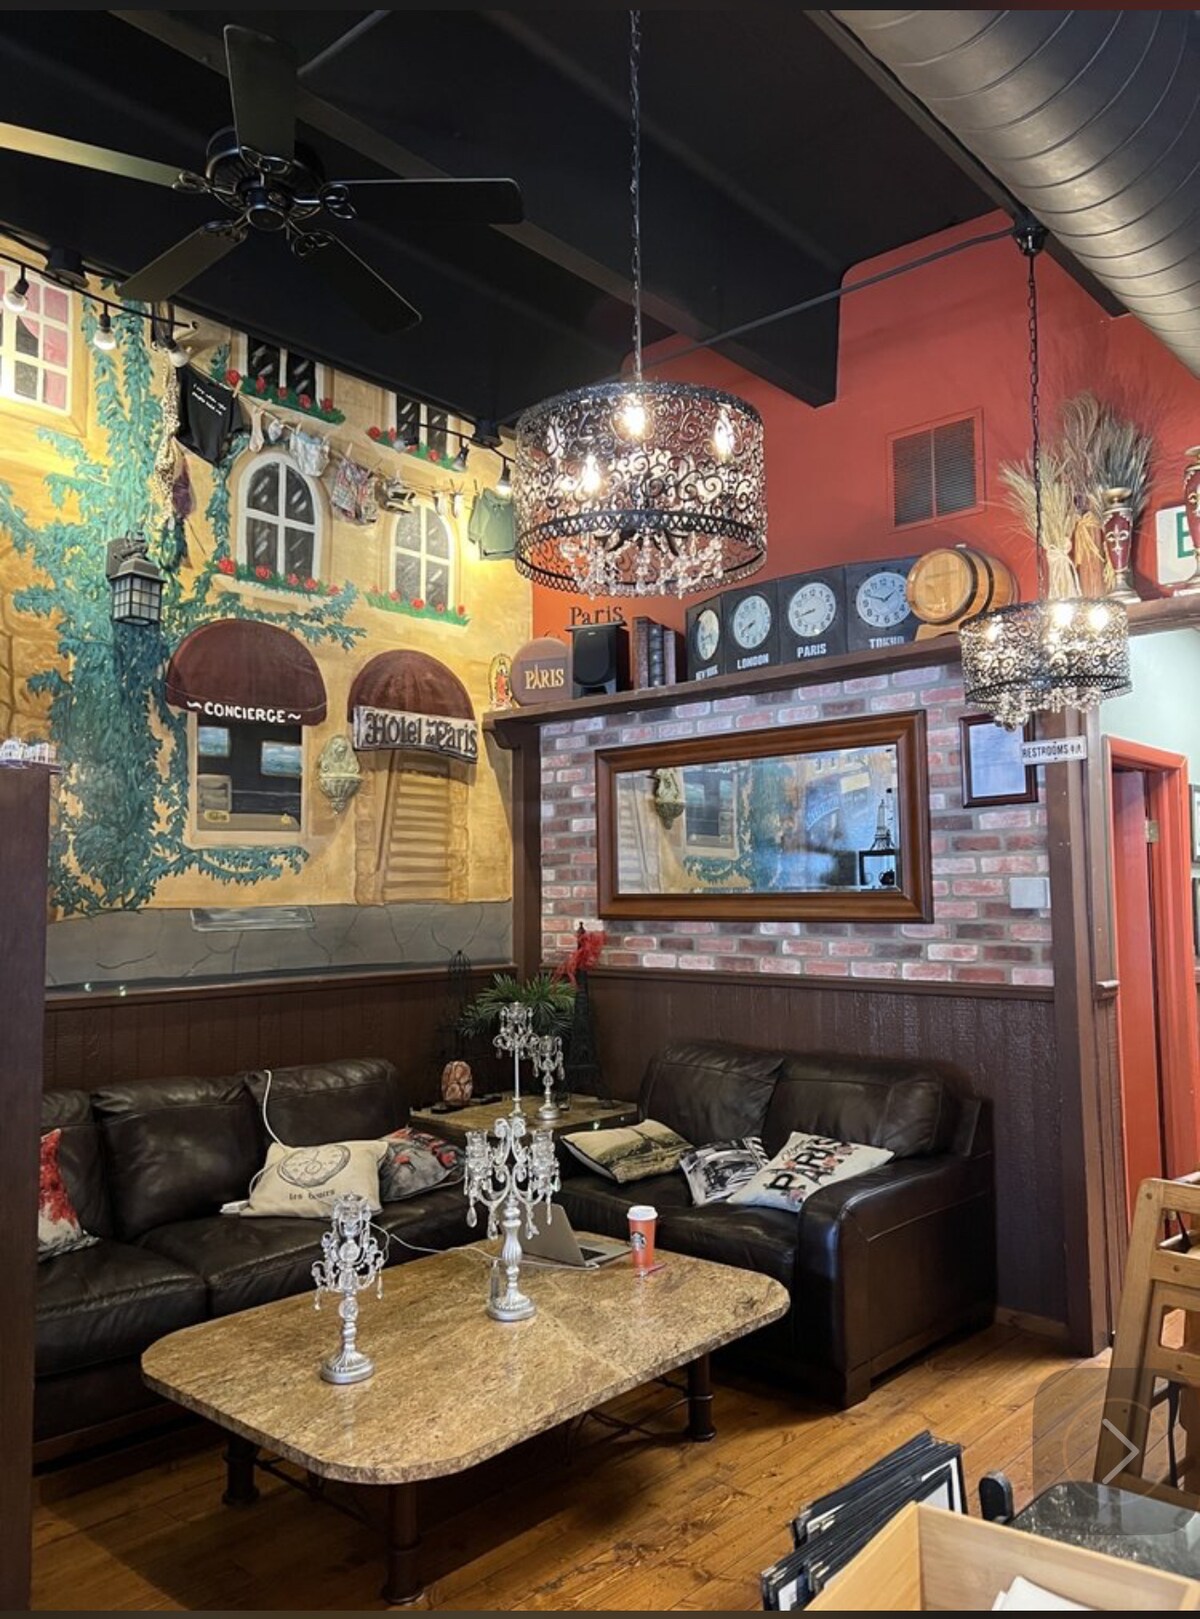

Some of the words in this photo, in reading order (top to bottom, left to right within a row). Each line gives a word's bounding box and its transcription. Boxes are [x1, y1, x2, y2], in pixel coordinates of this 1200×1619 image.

[570, 606, 624, 626] Paris
[797, 643, 827, 658] PARIS
[737, 653, 769, 670] LONDON
[525, 664, 564, 690] PARIS
[204, 701, 286, 724] CONCIERGE
[428, 719, 478, 753] Paris
[1022, 744, 1069, 759] RESTROOMS
